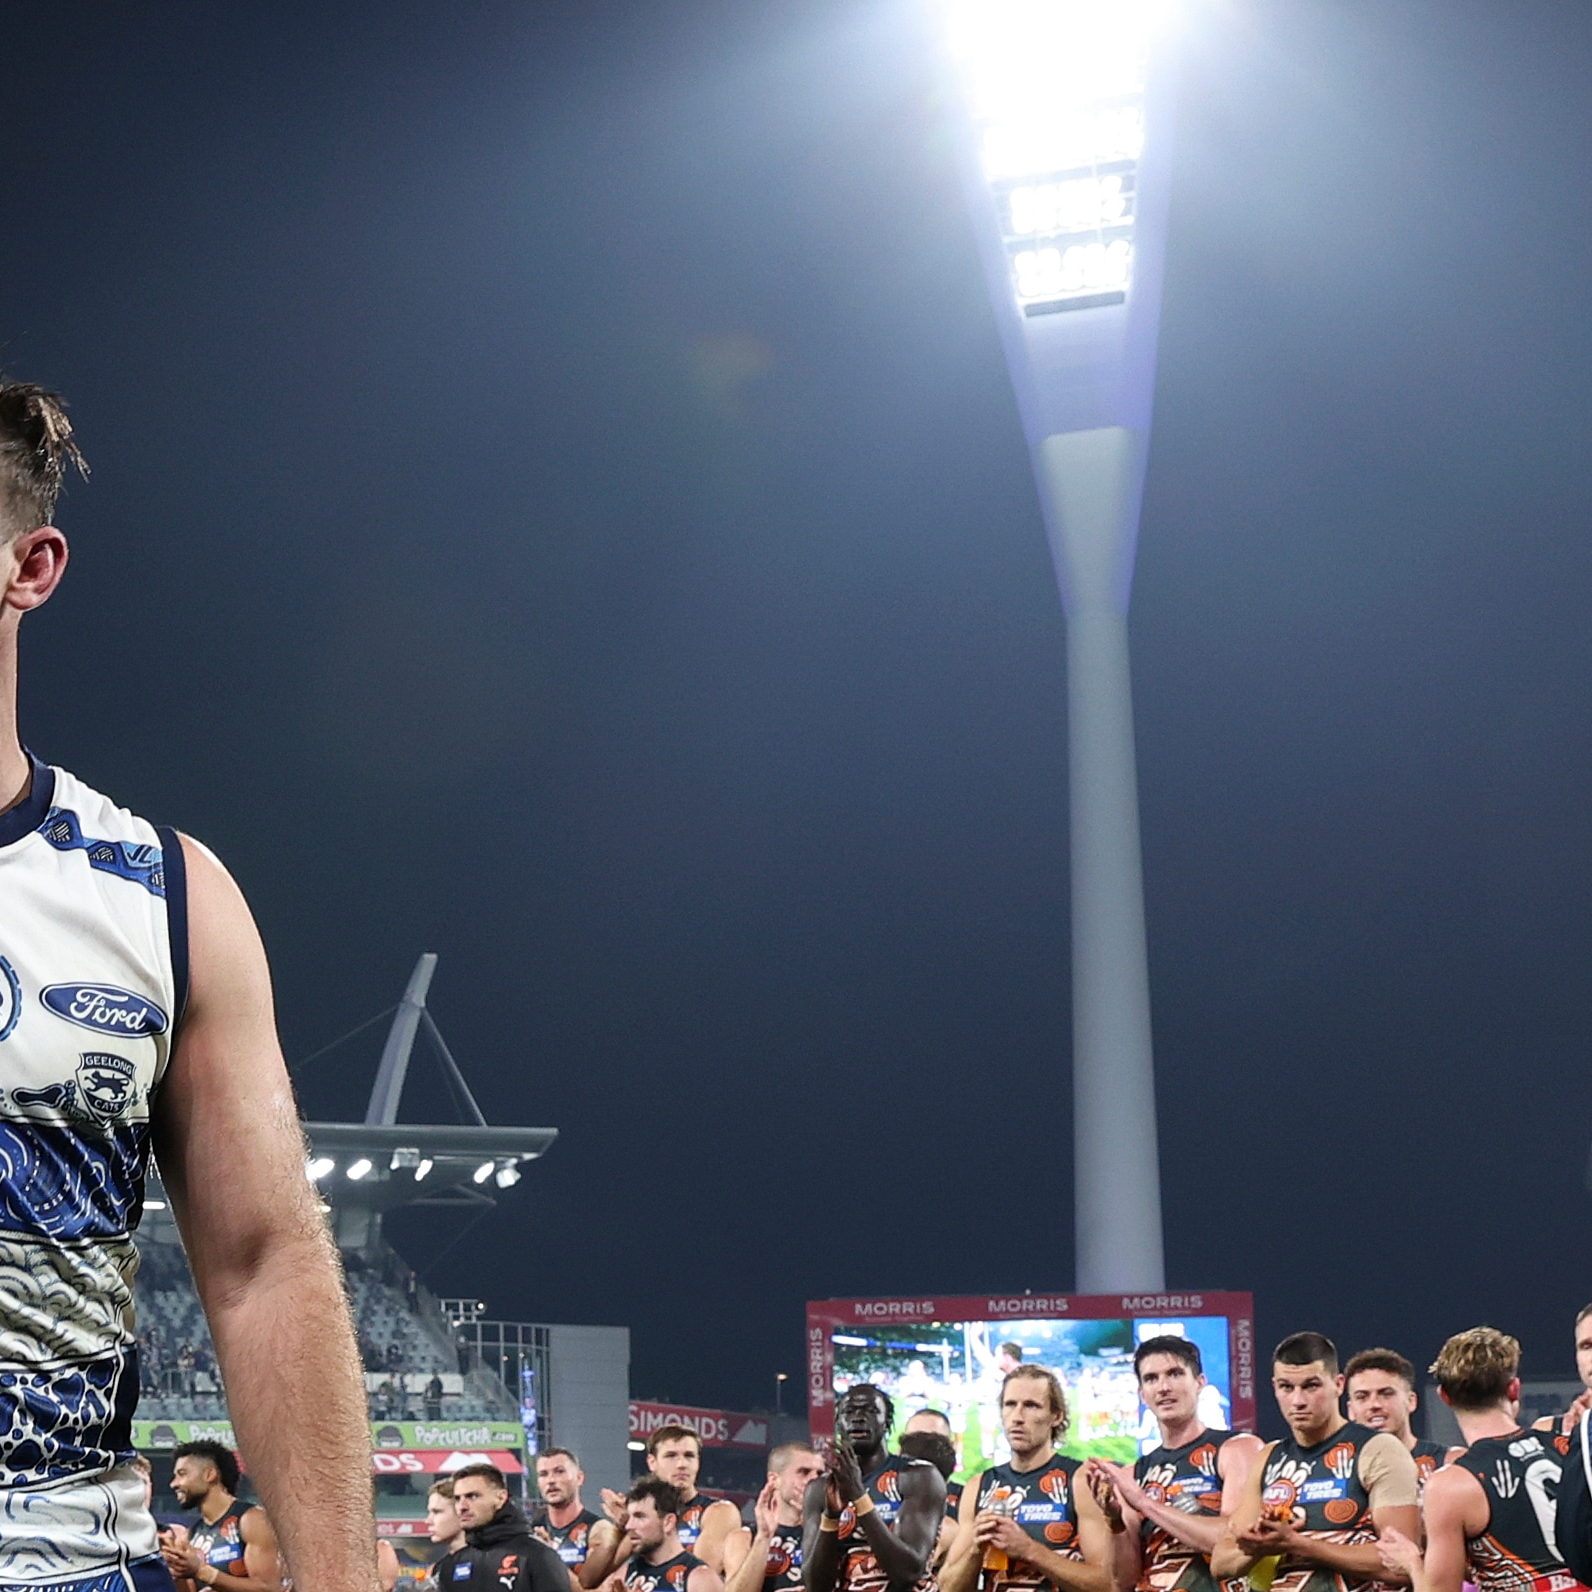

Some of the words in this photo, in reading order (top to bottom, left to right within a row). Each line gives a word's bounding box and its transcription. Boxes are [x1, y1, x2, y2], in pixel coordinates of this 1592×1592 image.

[70, 988, 148, 1030] Ford
[85, 1055, 133, 1075] GEELONG
[95, 1099, 120, 1111] CATS
[855, 1301, 935, 1316] MORRIS
[988, 1298, 1069, 1313] MORRIS
[1122, 1295, 1203, 1310] MORRIS
[1237, 1319, 1253, 1399] MORRIS
[809, 1327, 824, 1407] MORRIS
[628, 1405, 729, 1441] SIMONDS
[1262, 1487, 1290, 1500] AFL
[1020, 1503, 1053, 1512] TOYO
[1023, 1511, 1064, 1521] TIRES
